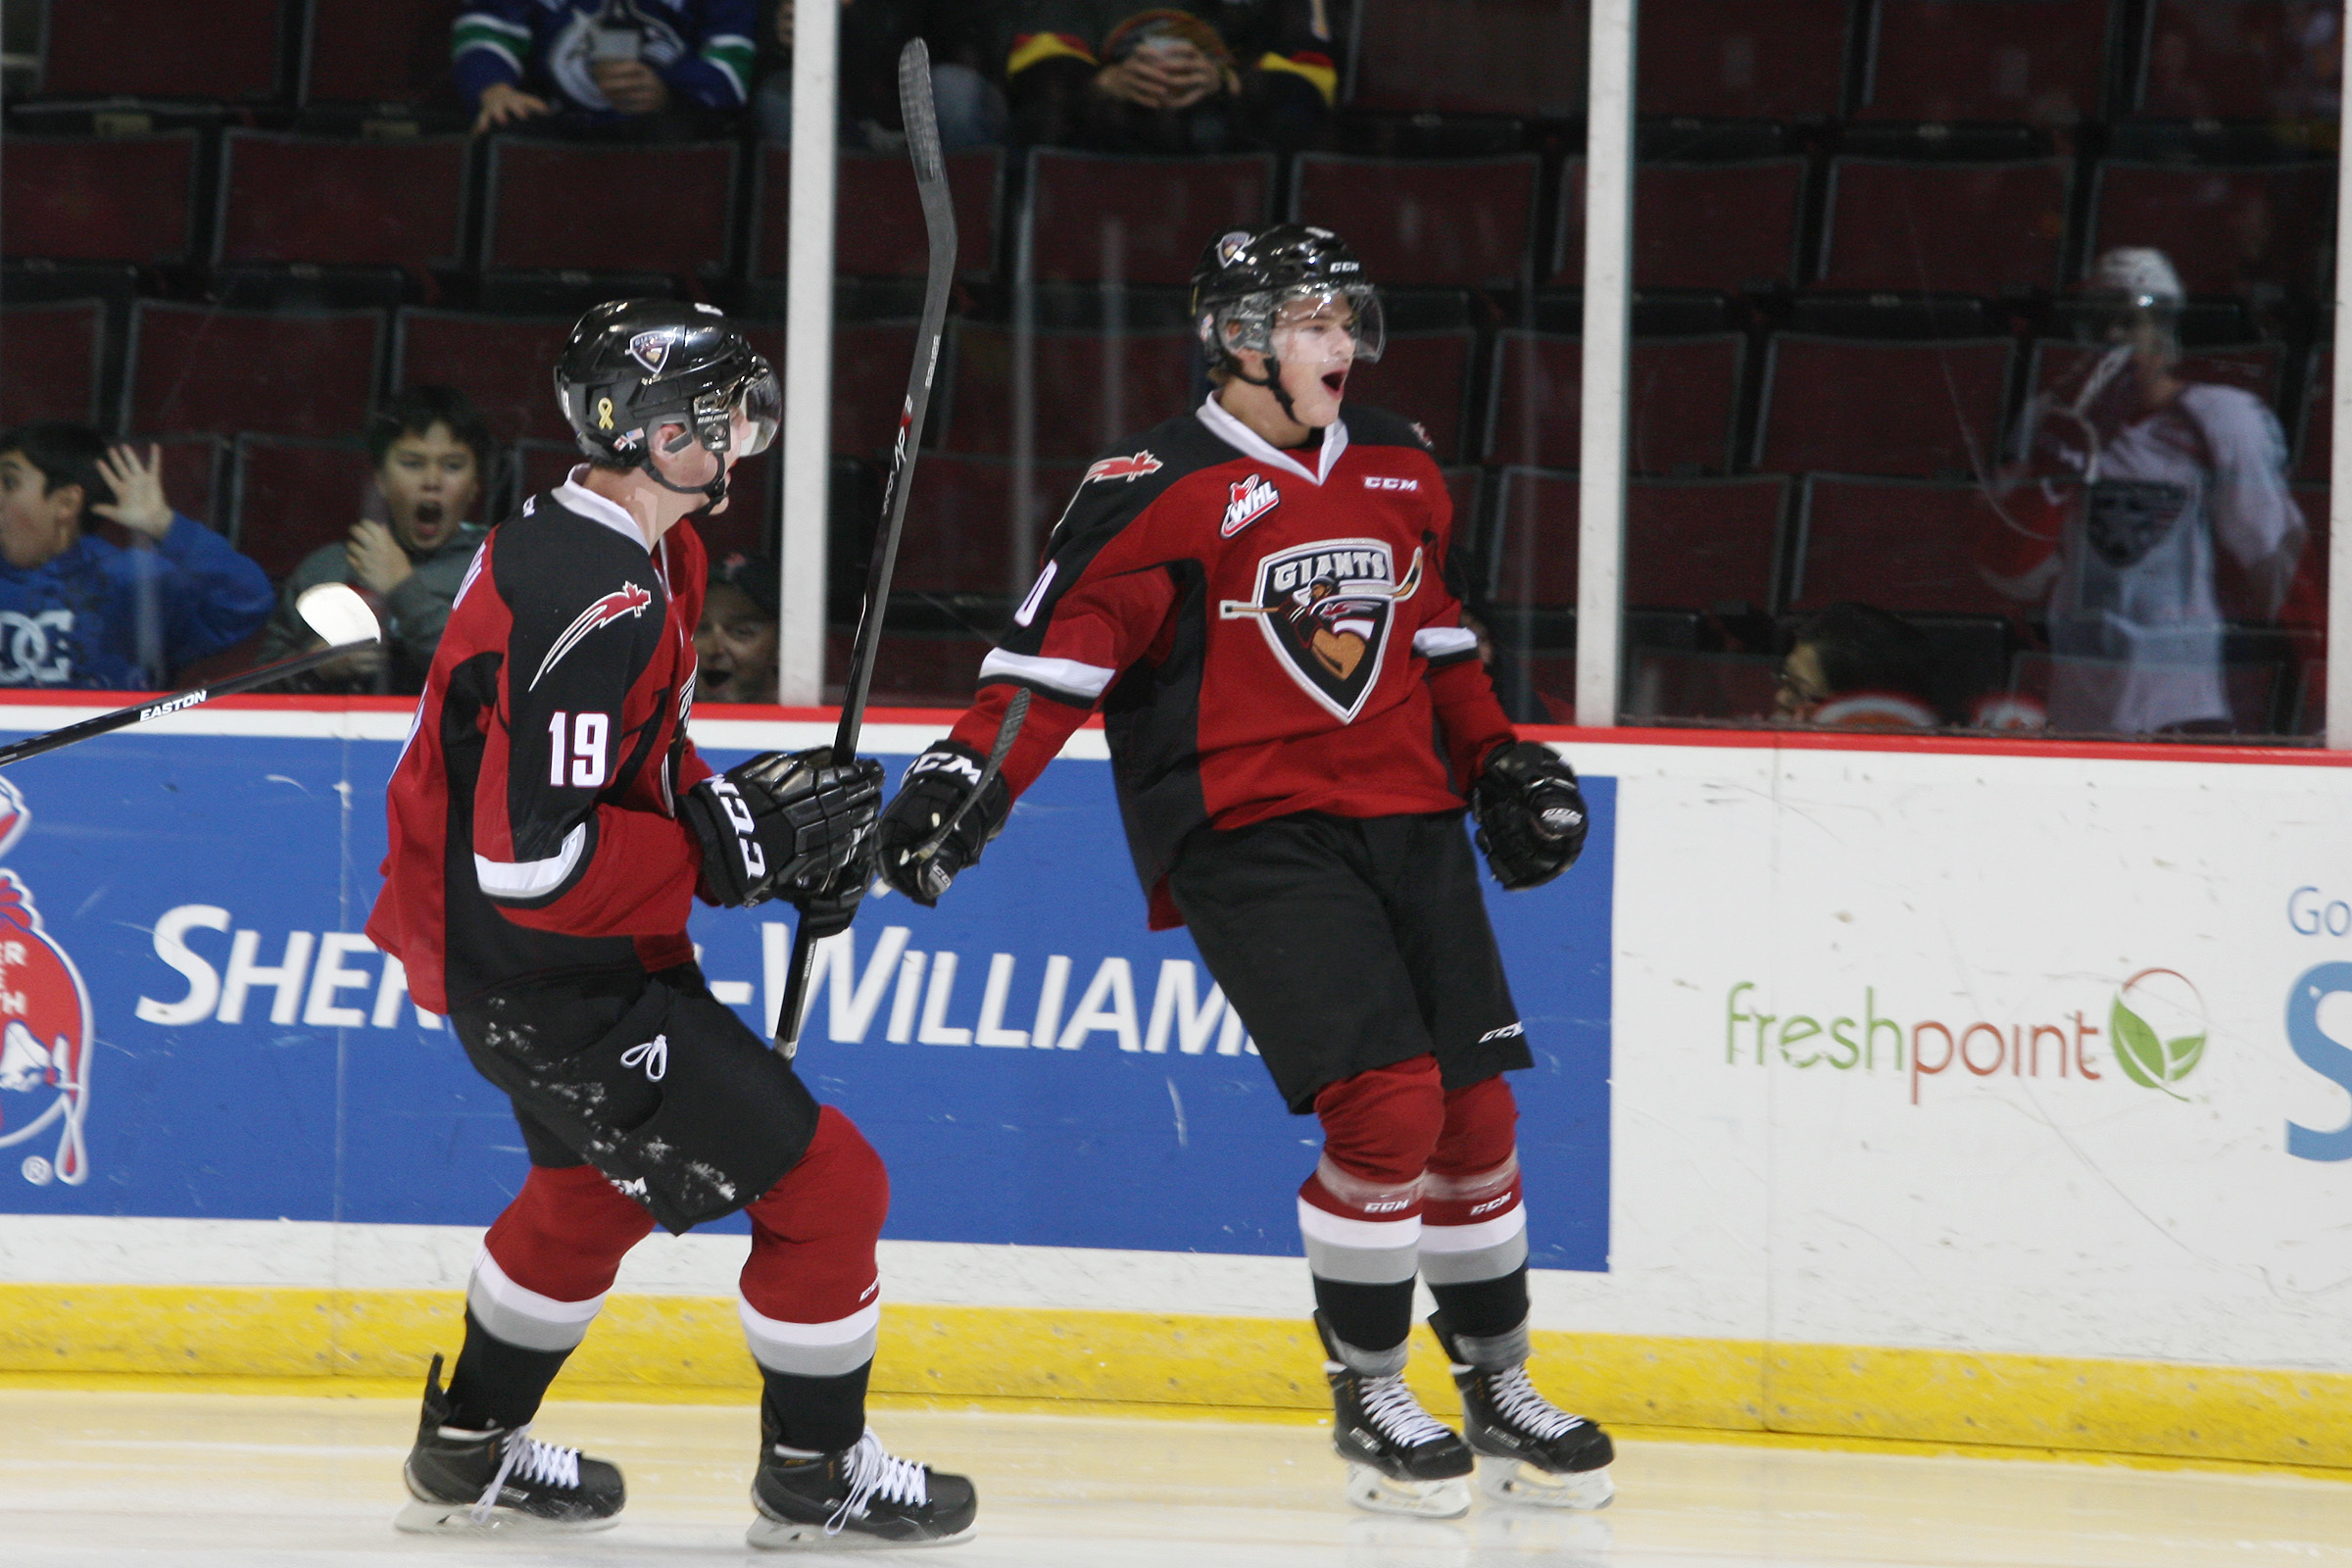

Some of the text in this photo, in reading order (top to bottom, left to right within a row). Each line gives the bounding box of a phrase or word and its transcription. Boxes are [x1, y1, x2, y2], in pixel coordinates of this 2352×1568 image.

[1329, 261, 1360, 273] CCM
[1363, 476, 1419, 491] CCM
[1226, 479, 1280, 524] WHL
[1274, 550, 1388, 592] GIANTS
[139, 689, 208, 722] EASTON
[549, 711, 610, 788] 19
[1726, 981, 2104, 1105] freshpoint
[1363, 1199, 1410, 1214] CCM
[1470, 1191, 1513, 1217] CCM
